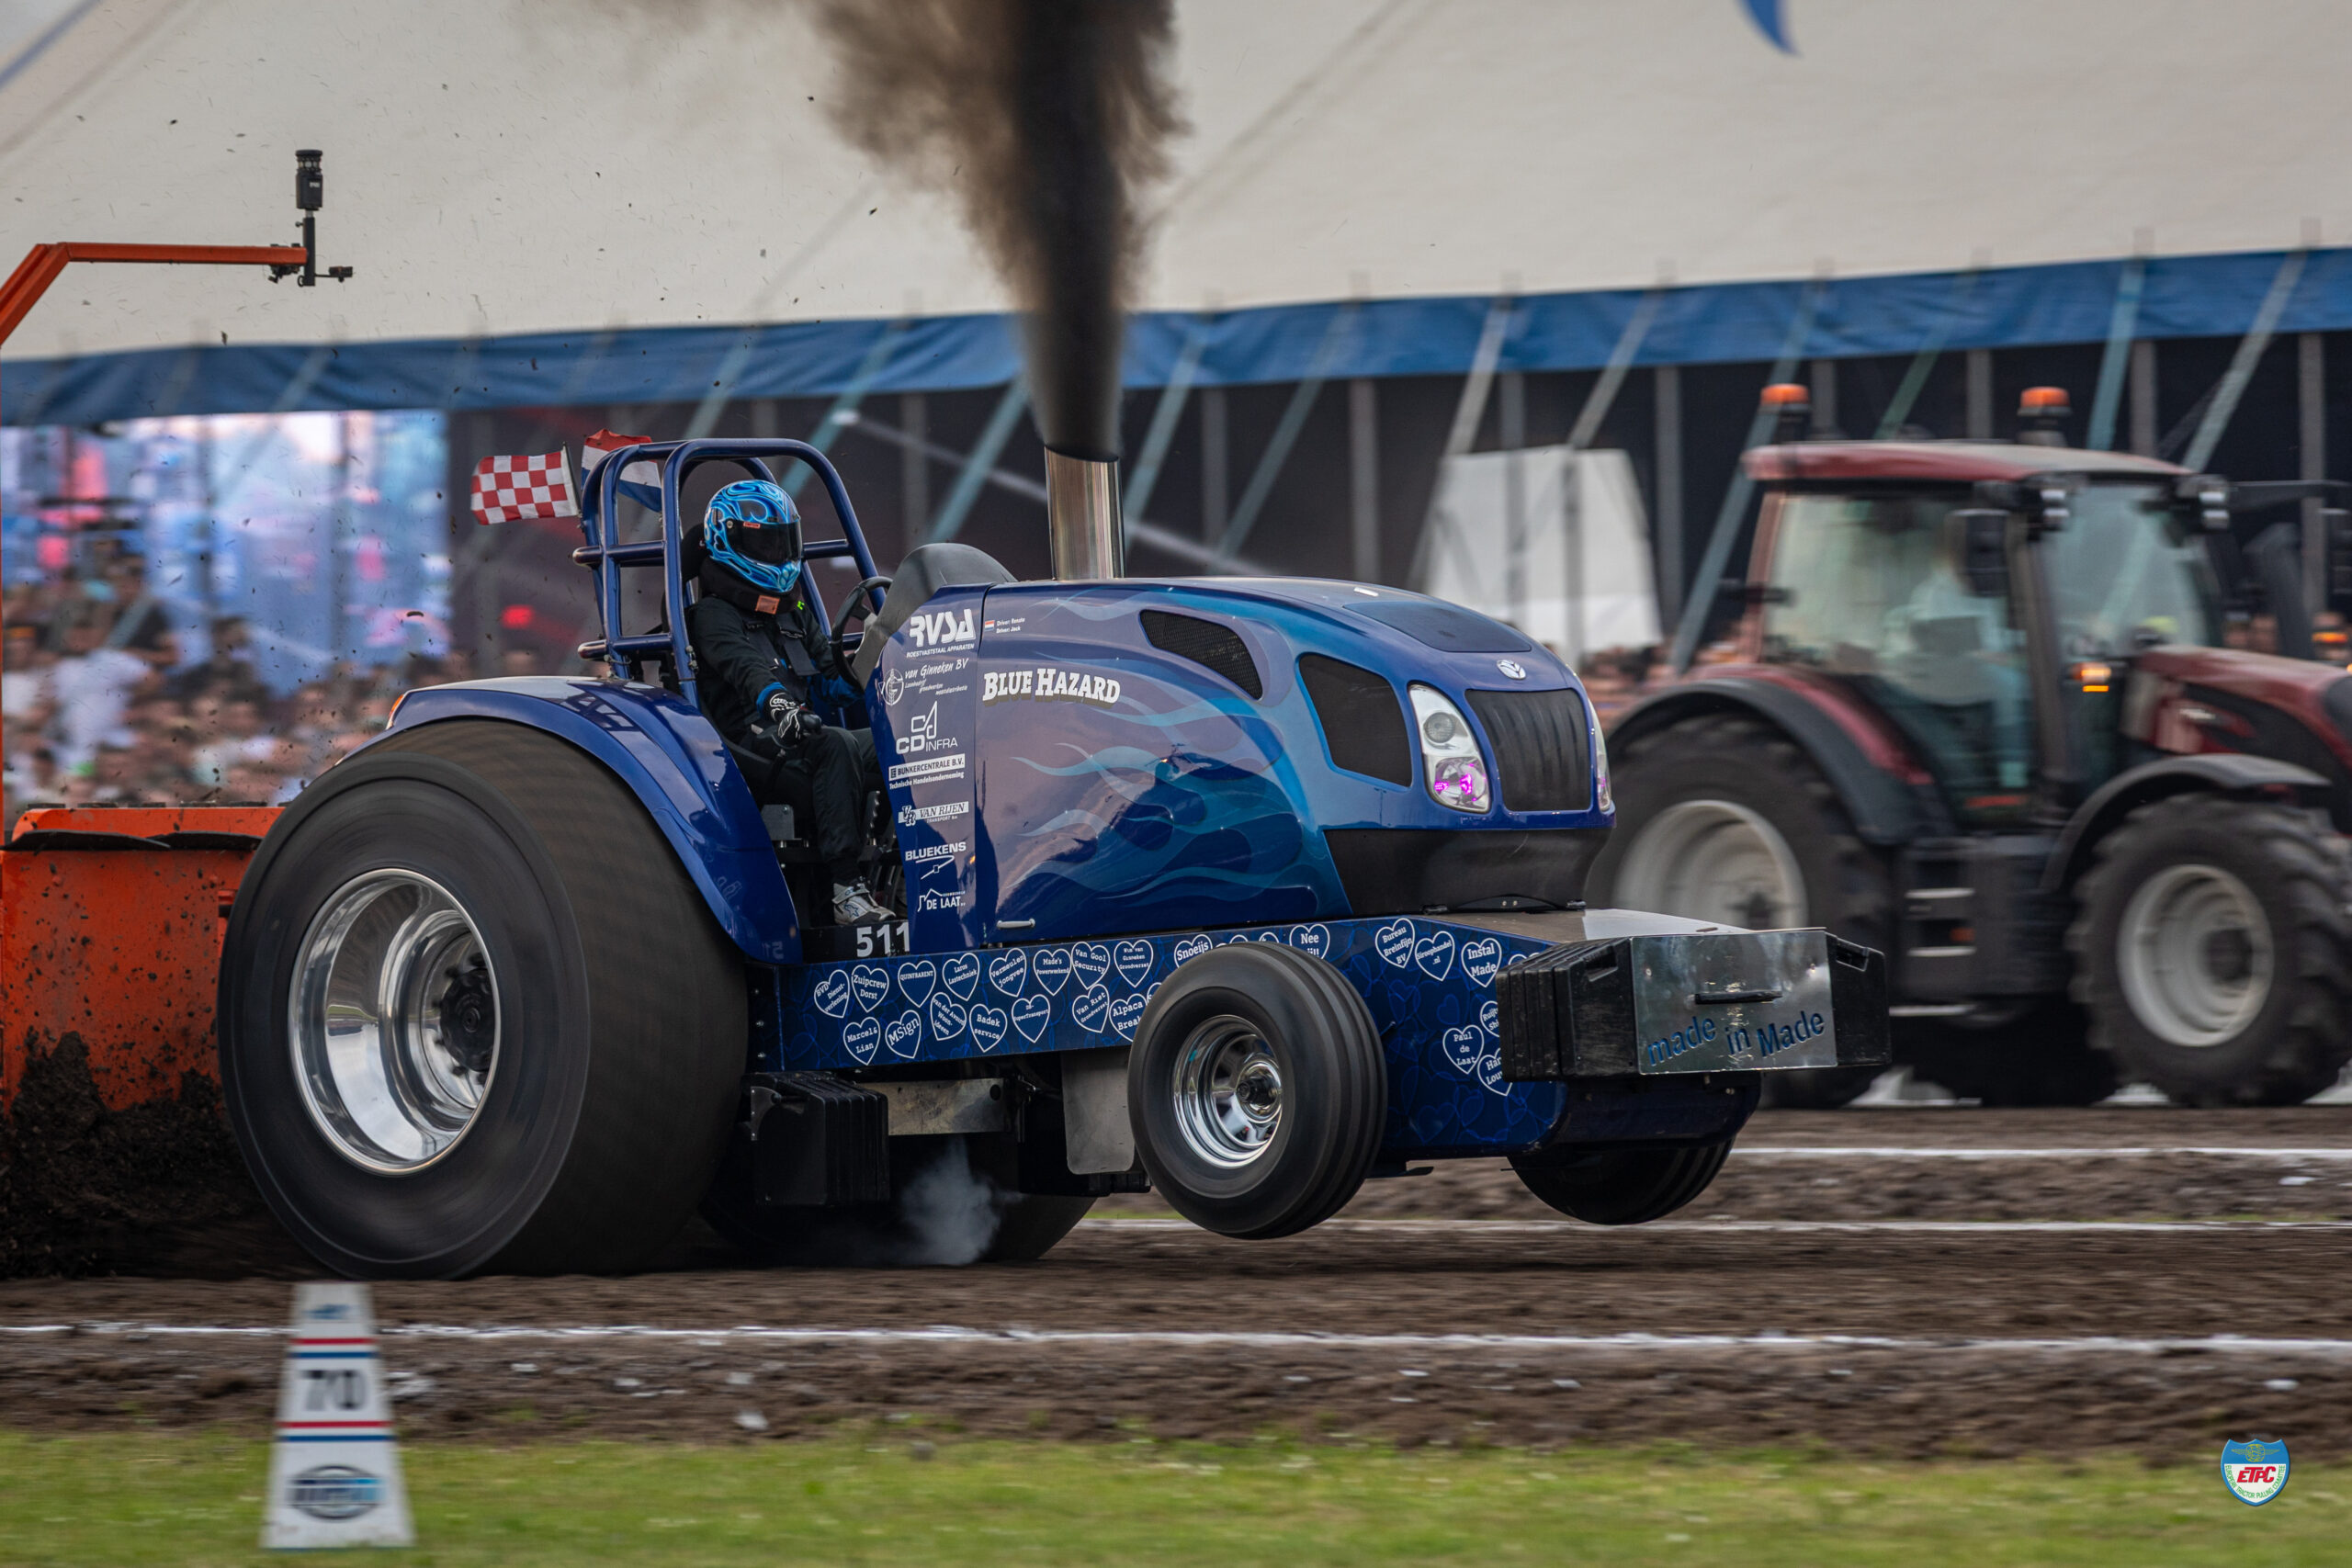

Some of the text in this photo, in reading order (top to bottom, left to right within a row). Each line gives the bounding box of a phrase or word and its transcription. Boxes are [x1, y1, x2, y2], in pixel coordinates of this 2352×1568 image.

[910, 608, 977, 647] RVSA
[947, 643, 975, 652] APPARATEN
[905, 658, 969, 679] van Ginneken BV
[925, 737, 958, 752] INFRA
[898, 757, 964, 775] BUNKERCENTRALE B.V.
[889, 772, 965, 790] Technische Handelsonderneming
[920, 803, 966, 818] VAN RIJEN
[905, 841, 967, 861] BLUEKENS
[926, 898, 937, 910] DE
[940, 896, 961, 908] LAAT
[856, 921, 910, 957] 511
[1300, 933, 1319, 944] Nee
[1382, 927, 1408, 943] Bureau
[1075, 949, 1106, 962] Van Gool
[1176, 941, 1209, 961] Snoeijs
[1417, 940, 1453, 960] Siroophandel
[1467, 942, 1496, 960] Instal
[991, 955, 1024, 977] Vermeulen
[1396, 953, 1407, 964] BV
[954, 964, 968, 973] Laros
[1074, 960, 1106, 975] Security
[1470, 962, 1497, 977] Made
[854, 975, 887, 989] Zuipcrew
[948, 969, 978, 985] Lastechniek
[999, 967, 1024, 988] jongvee
[816, 983, 830, 997] BVD
[827, 983, 845, 999] Dienst-
[860, 988, 877, 1000] Dorst
[941, 1004, 951, 1014] der
[1076, 992, 1106, 1015] Van Riet
[1113, 1001, 1144, 1017] Alpaca
[976, 1013, 1001, 1027] Badek
[888, 1018, 920, 1046] MSign
[974, 1028, 1001, 1040] service
[1453, 1031, 1473, 1042] Paul
[1647, 1010, 1825, 1066] made in Made
[855, 1043, 875, 1054] Lian
[1459, 1045, 1470, 1054] de
[1456, 1056, 1476, 1066] Laat
[1486, 1056, 1501, 1071] Har
[300, 1369, 367, 1411] 70
